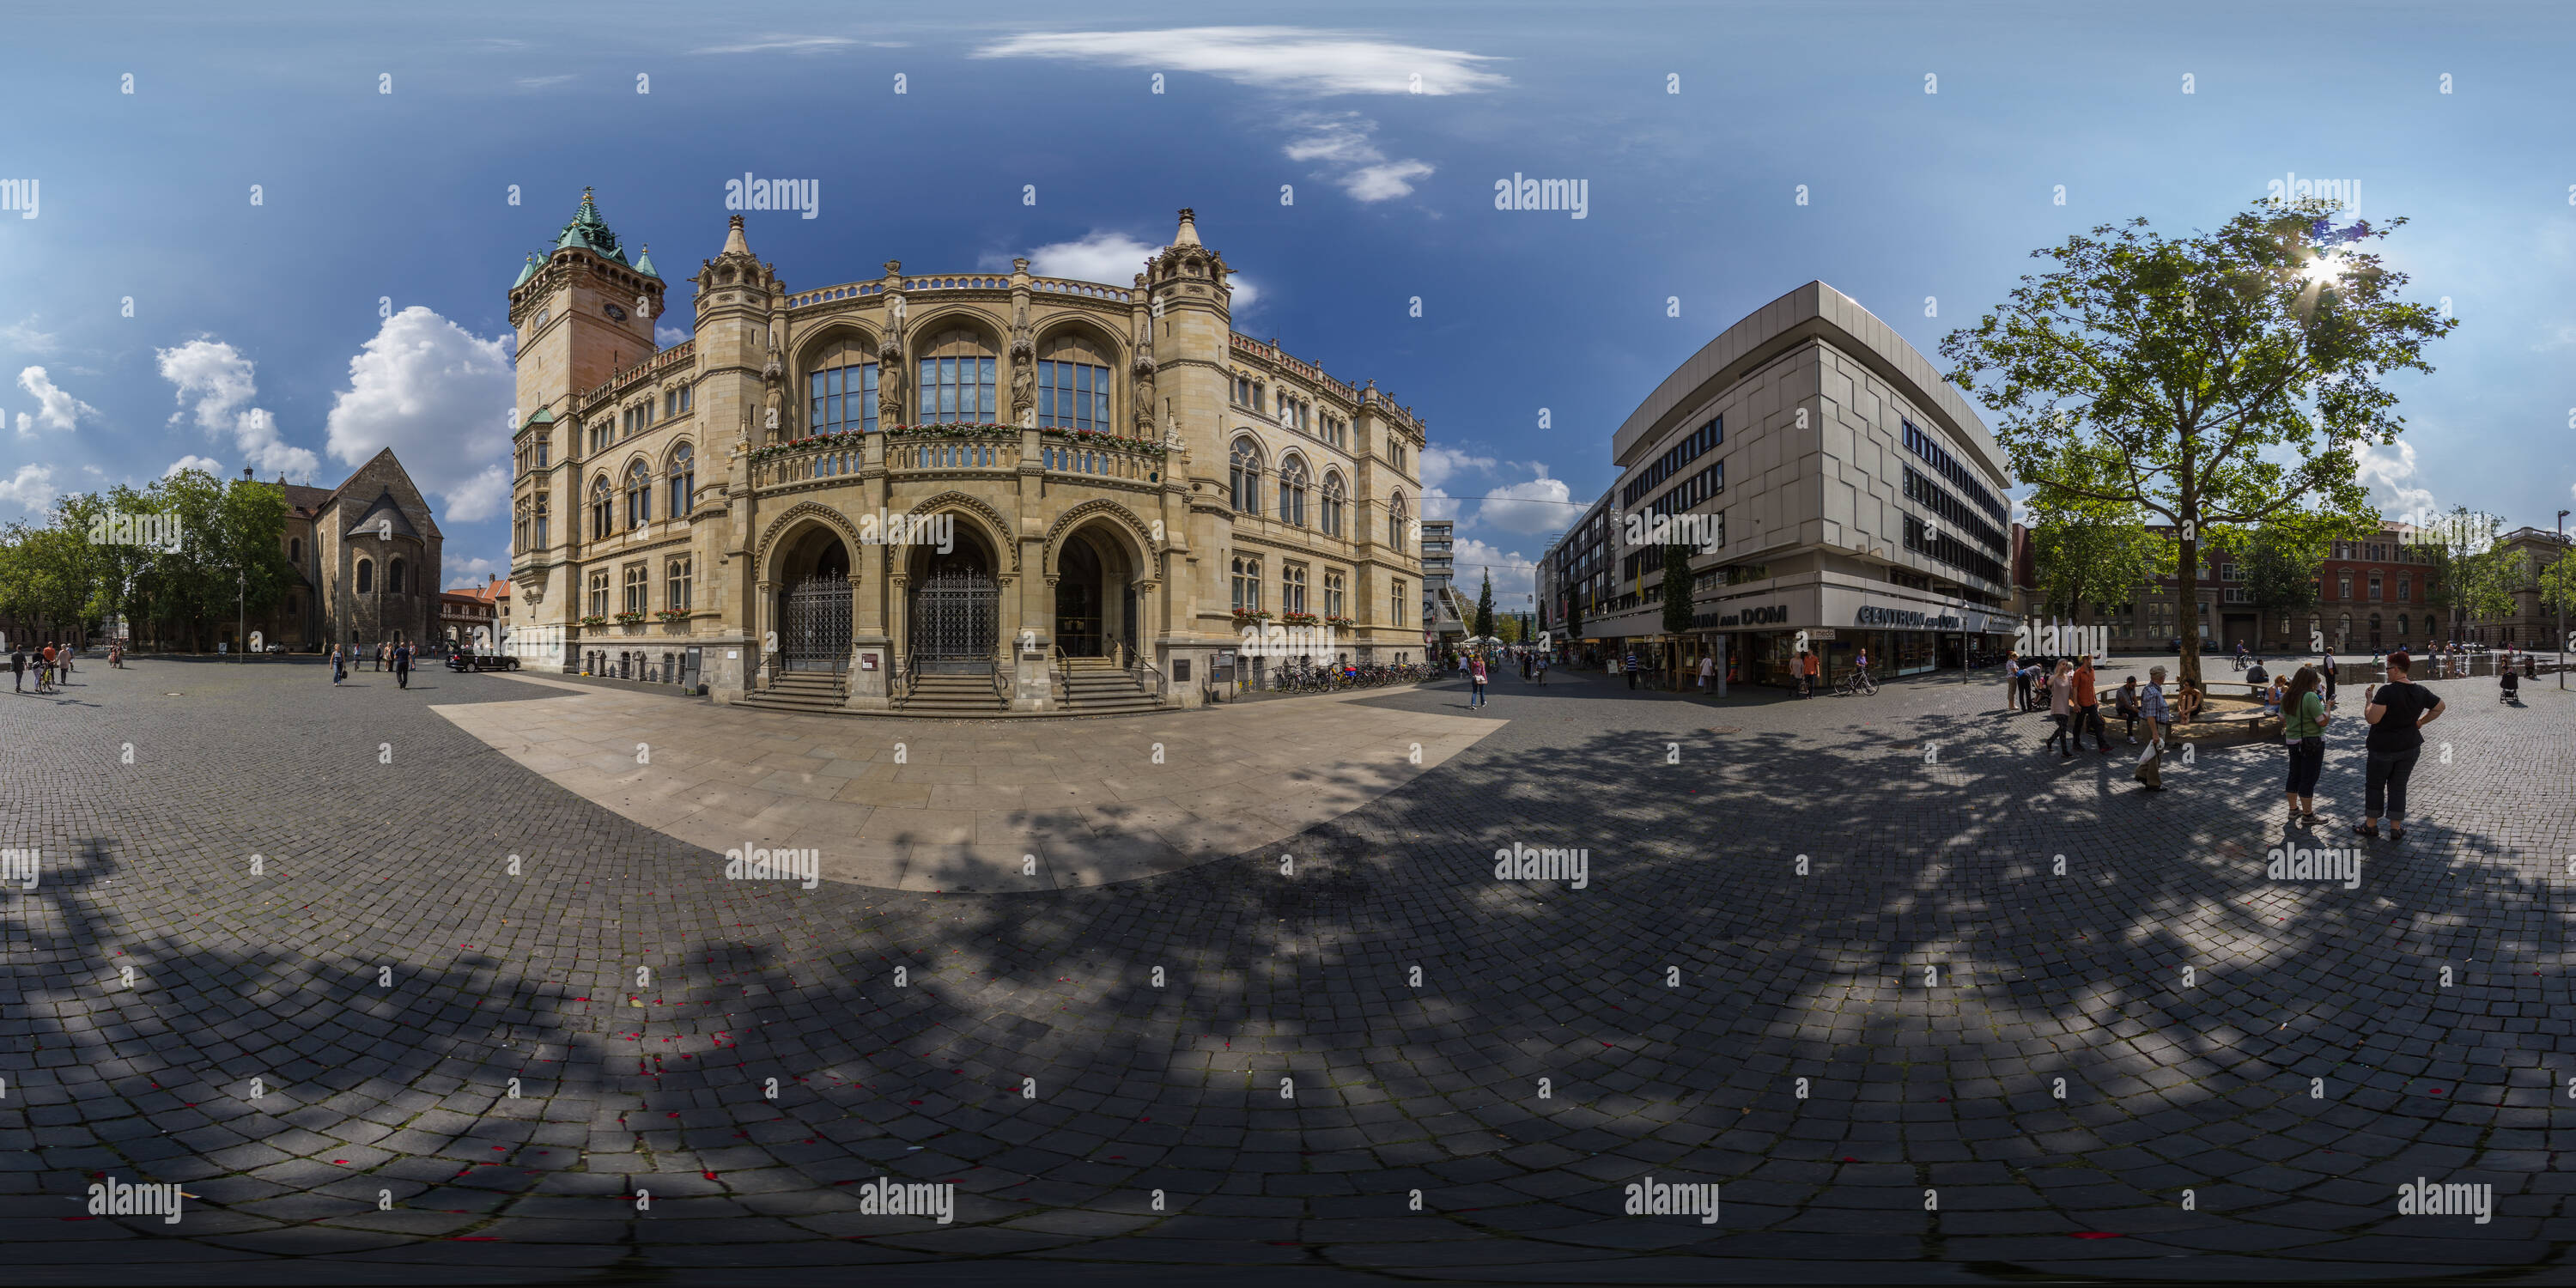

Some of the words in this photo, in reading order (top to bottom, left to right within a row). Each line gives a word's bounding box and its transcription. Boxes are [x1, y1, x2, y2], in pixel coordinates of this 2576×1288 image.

[1741, 605, 1787, 625] DOM
[1859, 605, 1925, 626] CENTRUM
[1927, 617, 1938, 626] AM
